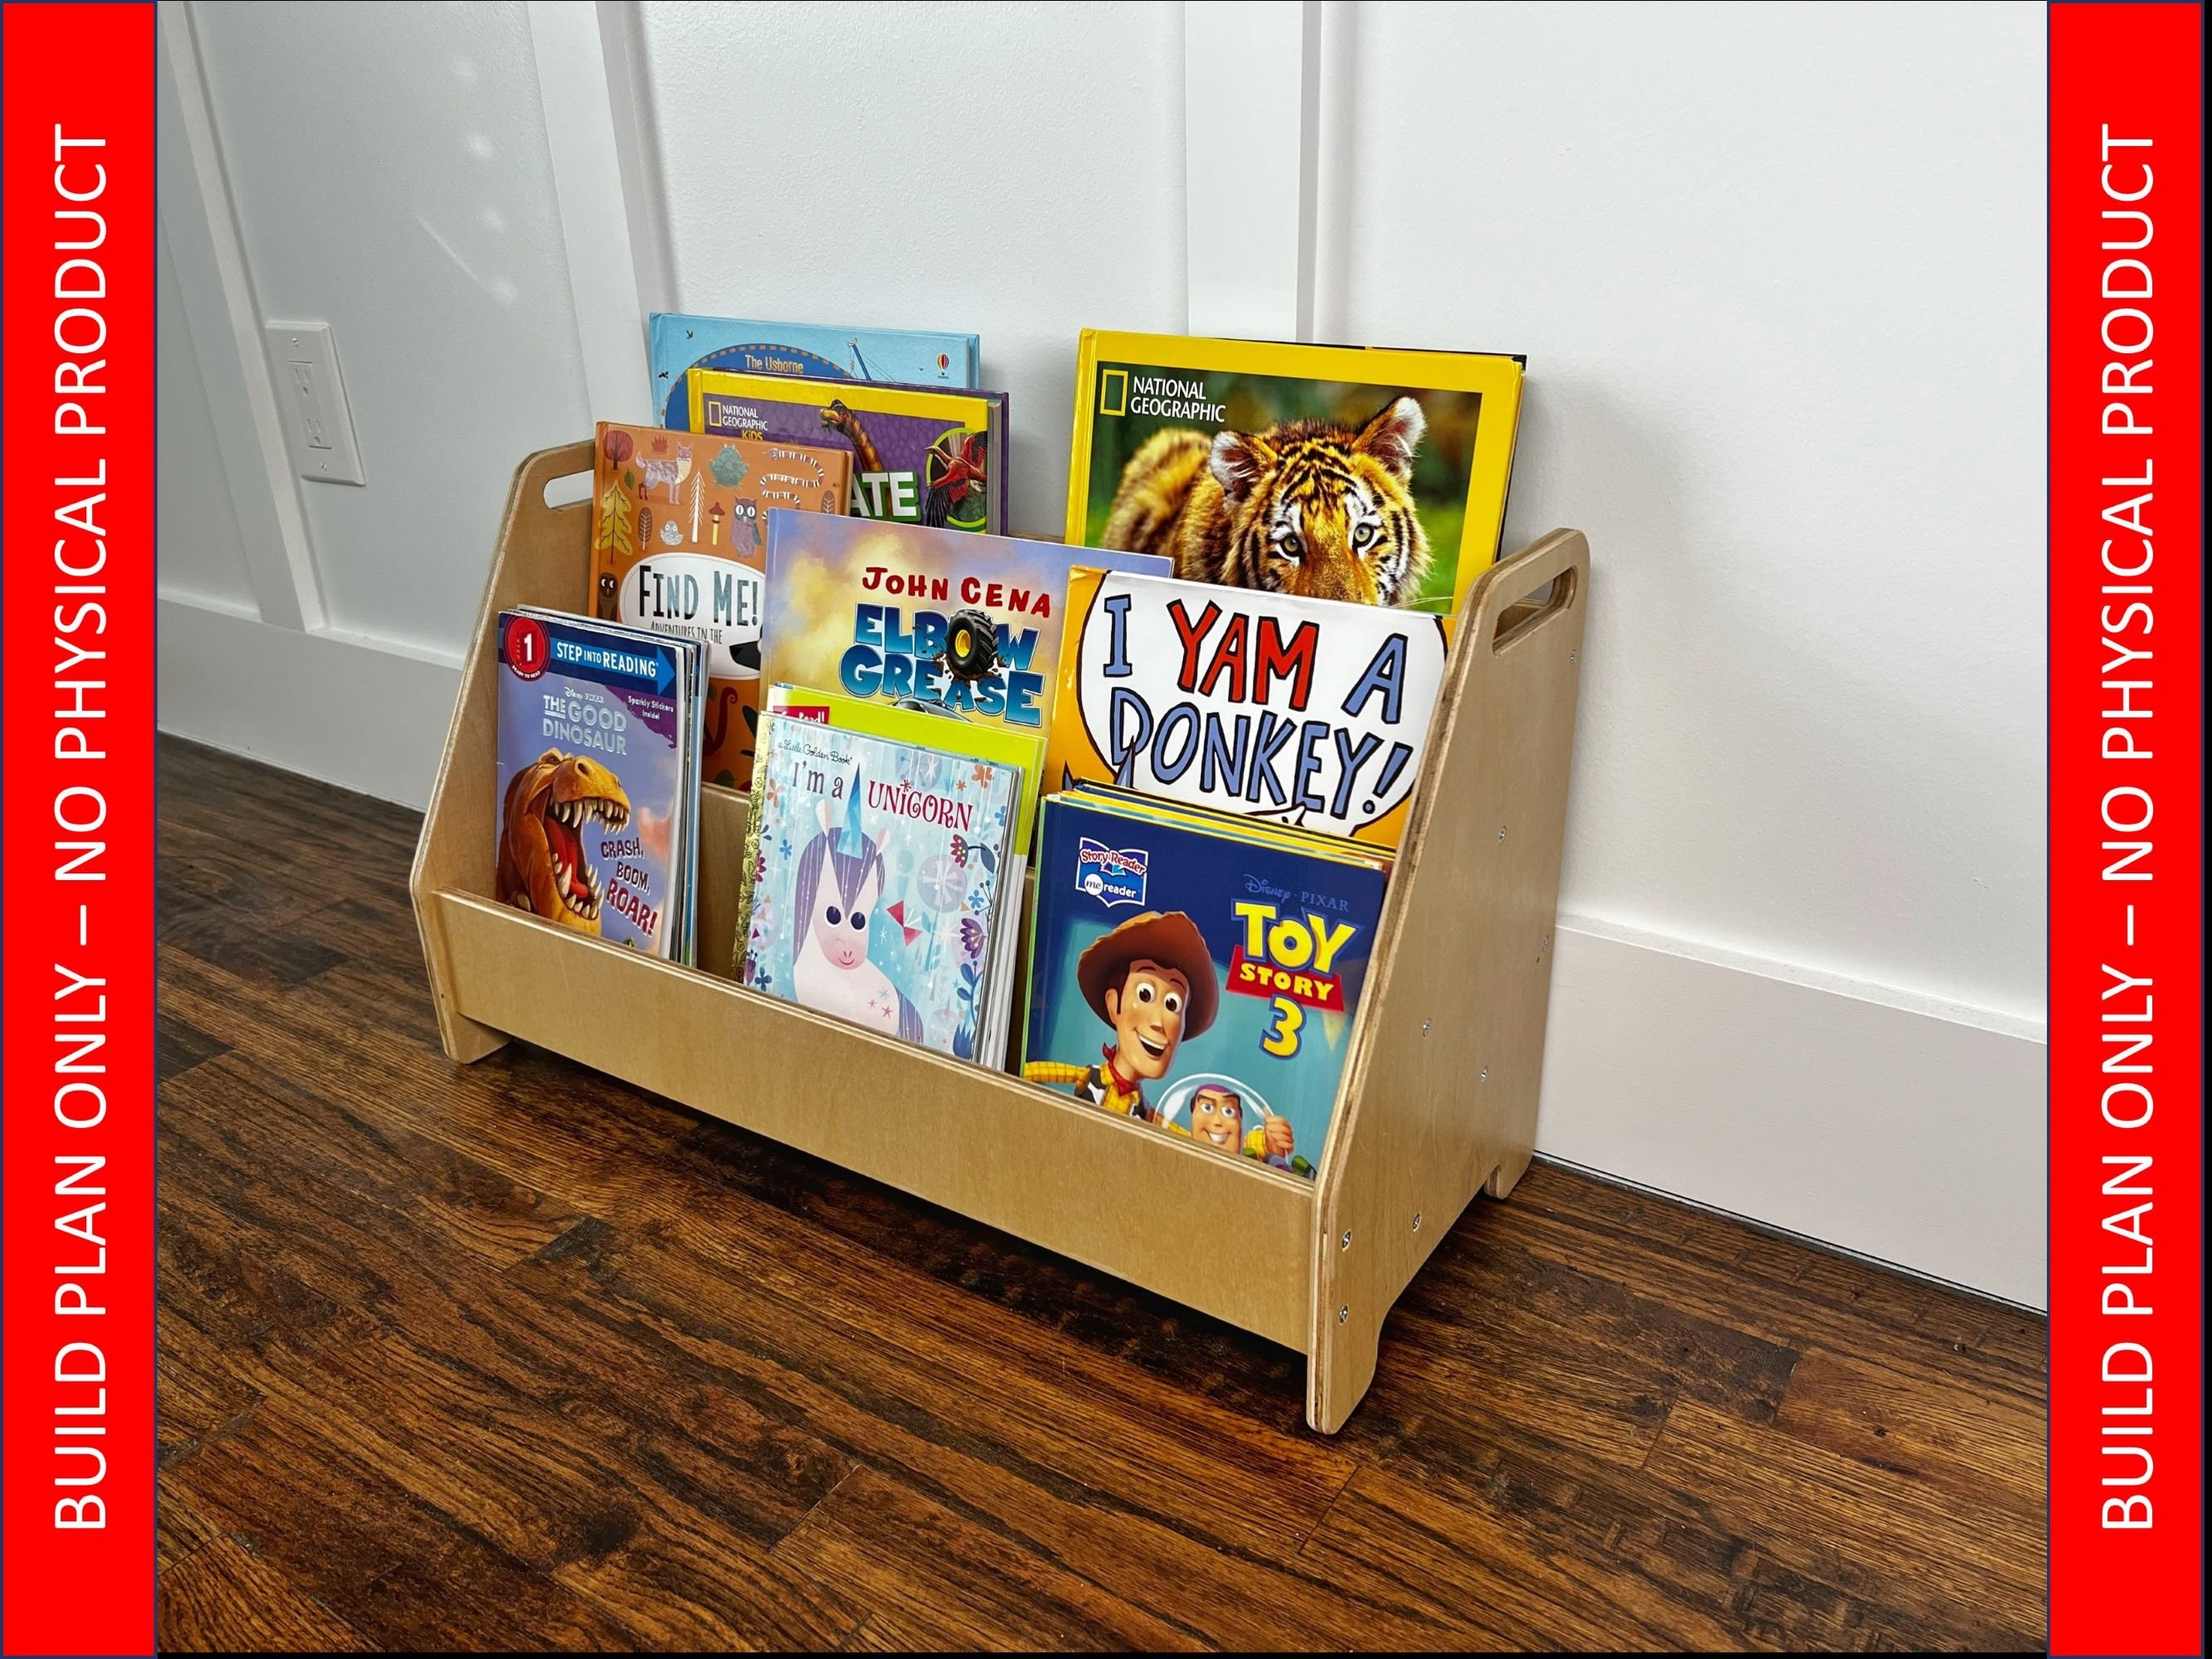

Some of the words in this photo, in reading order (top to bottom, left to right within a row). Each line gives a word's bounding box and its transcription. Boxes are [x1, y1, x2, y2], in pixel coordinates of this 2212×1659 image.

[744, 354, 763, 370] The
[765, 357, 804, 374] Usborne
[1133, 376, 1207, 400] NATIONAL
[722, 404, 758, 419] NATIONAL
[722, 416, 768, 431] GEOGRAPHIC
[1130, 396, 1226, 423] GEOGRAPHIC
[639, 565, 699, 620] FIND
[713, 570, 758, 626] ME!
[861, 566, 949, 601] JOHN
[960, 577, 1051, 619] CENA
[524, 632, 533, 662] 1
[709, 628, 723, 645] THE
[855, 602, 1040, 674] ELBOW
[556, 641, 582, 662] STEP
[583, 649, 602, 664] INTO
[602, 650, 656, 678] READING
[1103, 593, 1133, 677] I
[1166, 598, 1320, 712] YAM
[1341, 633, 1409, 725] A
[627, 695, 650, 709] Sparkly
[650, 699, 675, 713] Stickers
[839, 644, 1045, 728] GREASE
[543, 694, 567, 713] THE
[568, 700, 627, 732] GOOD
[641, 708, 660, 720] Inside!
[543, 718, 628, 756] DINOSAUR
[783, 738, 802, 753] Little
[802, 743, 830, 761] Golden
[1108, 687, 1414, 820] DONKEY!
[792, 760, 825, 795] I'm
[831, 776, 844, 800] a
[600, 836, 645, 860] CRASH,
[1079, 849, 1109, 864] Story
[1109, 849, 1147, 876] Reader
[616, 860, 650, 896] BOOM,
[1085, 879, 1102, 890] me
[1104, 883, 1137, 898] reader
[606, 877, 658, 937] ROAR!
[1300, 890, 1349, 912] PIXAR
[1232, 898, 1362, 977] TOY
[1240, 962, 1335, 1002] STORY
[1259, 996, 1306, 1060] 3
